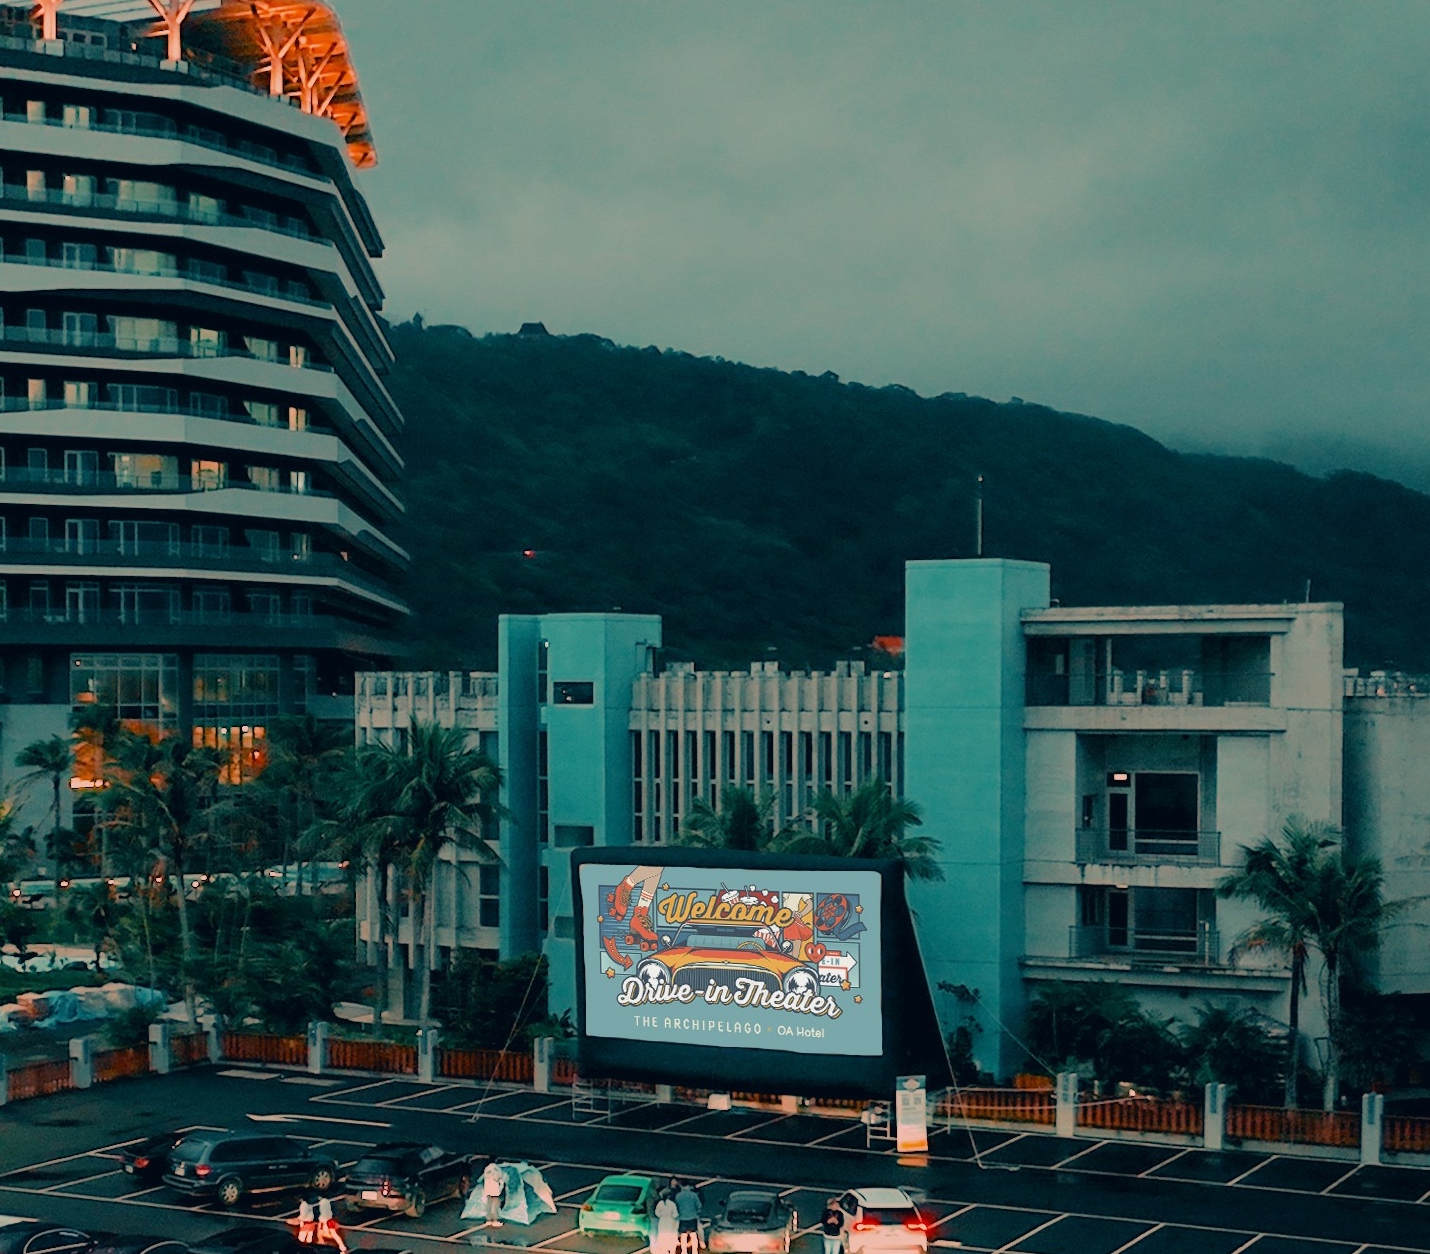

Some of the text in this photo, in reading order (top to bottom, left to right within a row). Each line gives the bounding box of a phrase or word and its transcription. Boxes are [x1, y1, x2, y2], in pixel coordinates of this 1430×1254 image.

[658, 891, 795, 928] Welcome
[618, 976, 843, 1019] Drive-in Theater
[633, 1015, 825, 1038] THE ARCHIPELAGO OA Hotel
